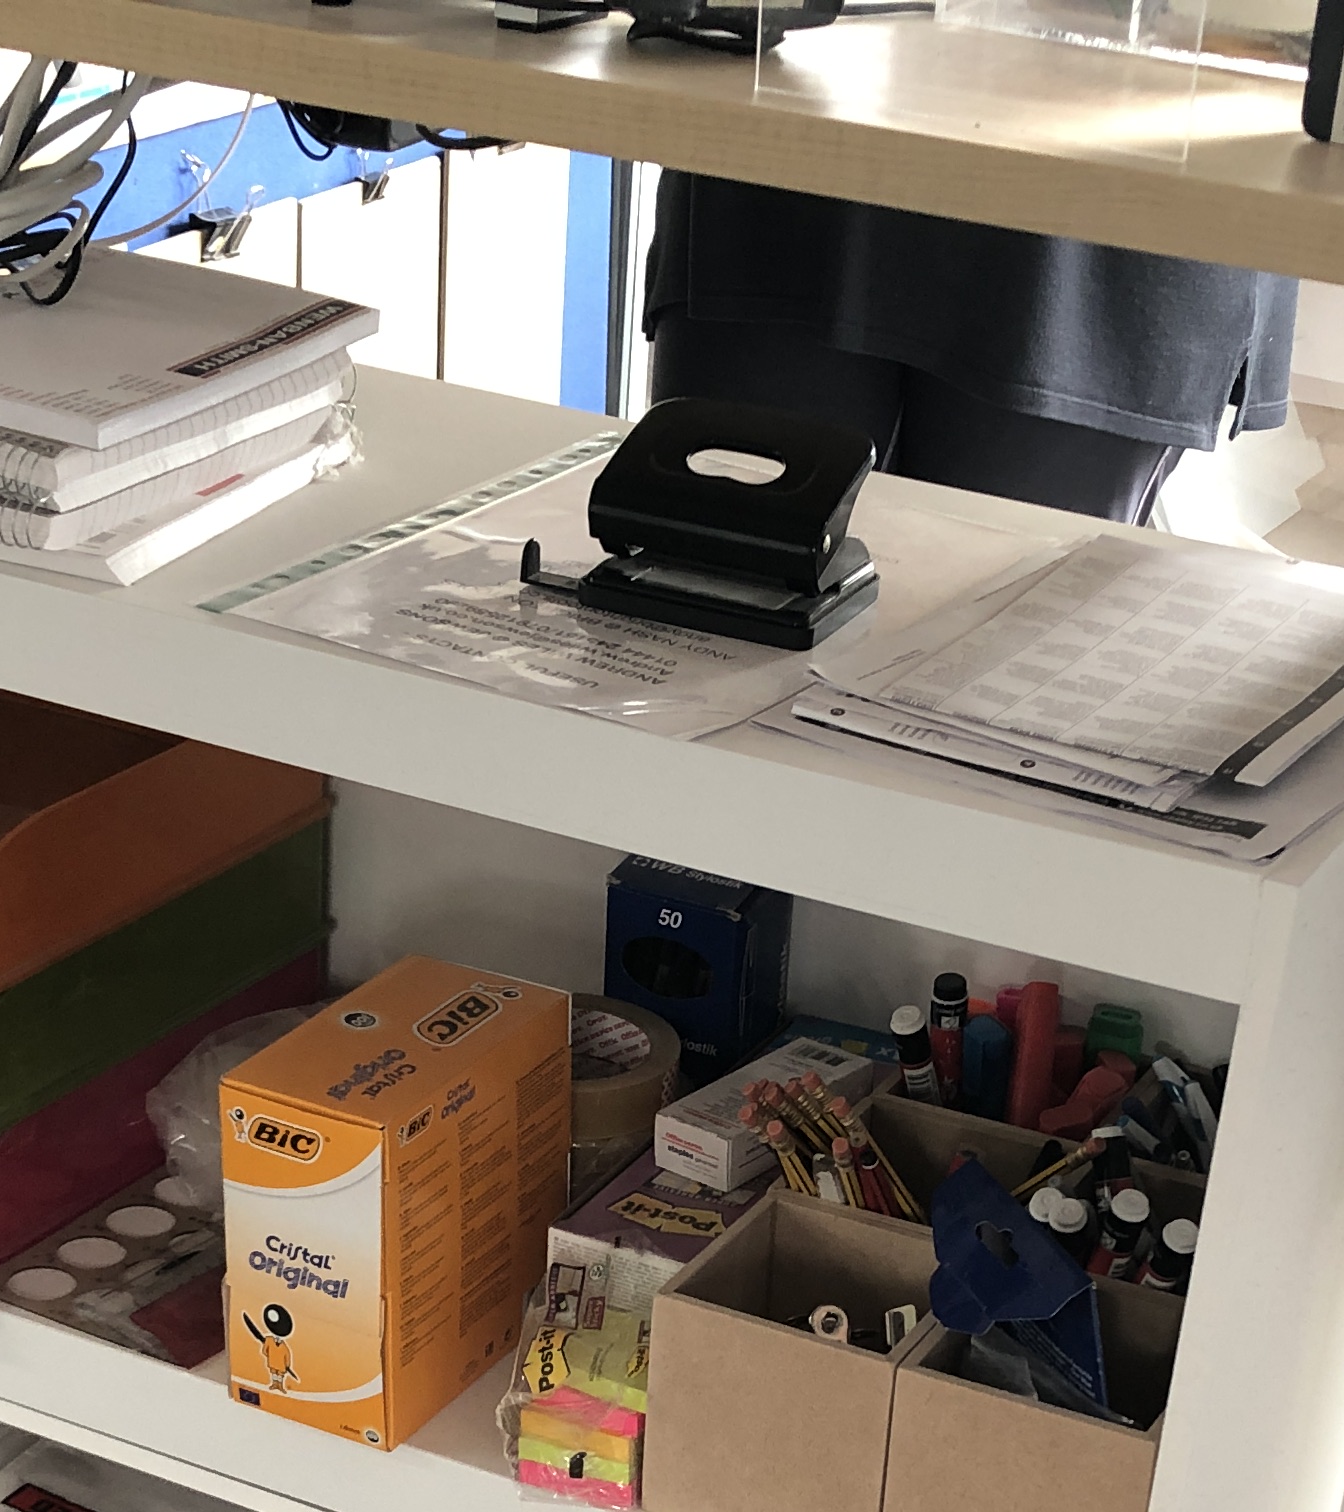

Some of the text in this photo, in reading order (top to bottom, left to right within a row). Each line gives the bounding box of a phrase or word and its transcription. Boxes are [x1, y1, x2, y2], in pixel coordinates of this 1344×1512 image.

[658, 908, 683, 929] 50
[620, 1200, 718, 1233] Post-it
[248, 1250, 350, 1299] Original
[538, 1328, 556, 1394] Post-it
